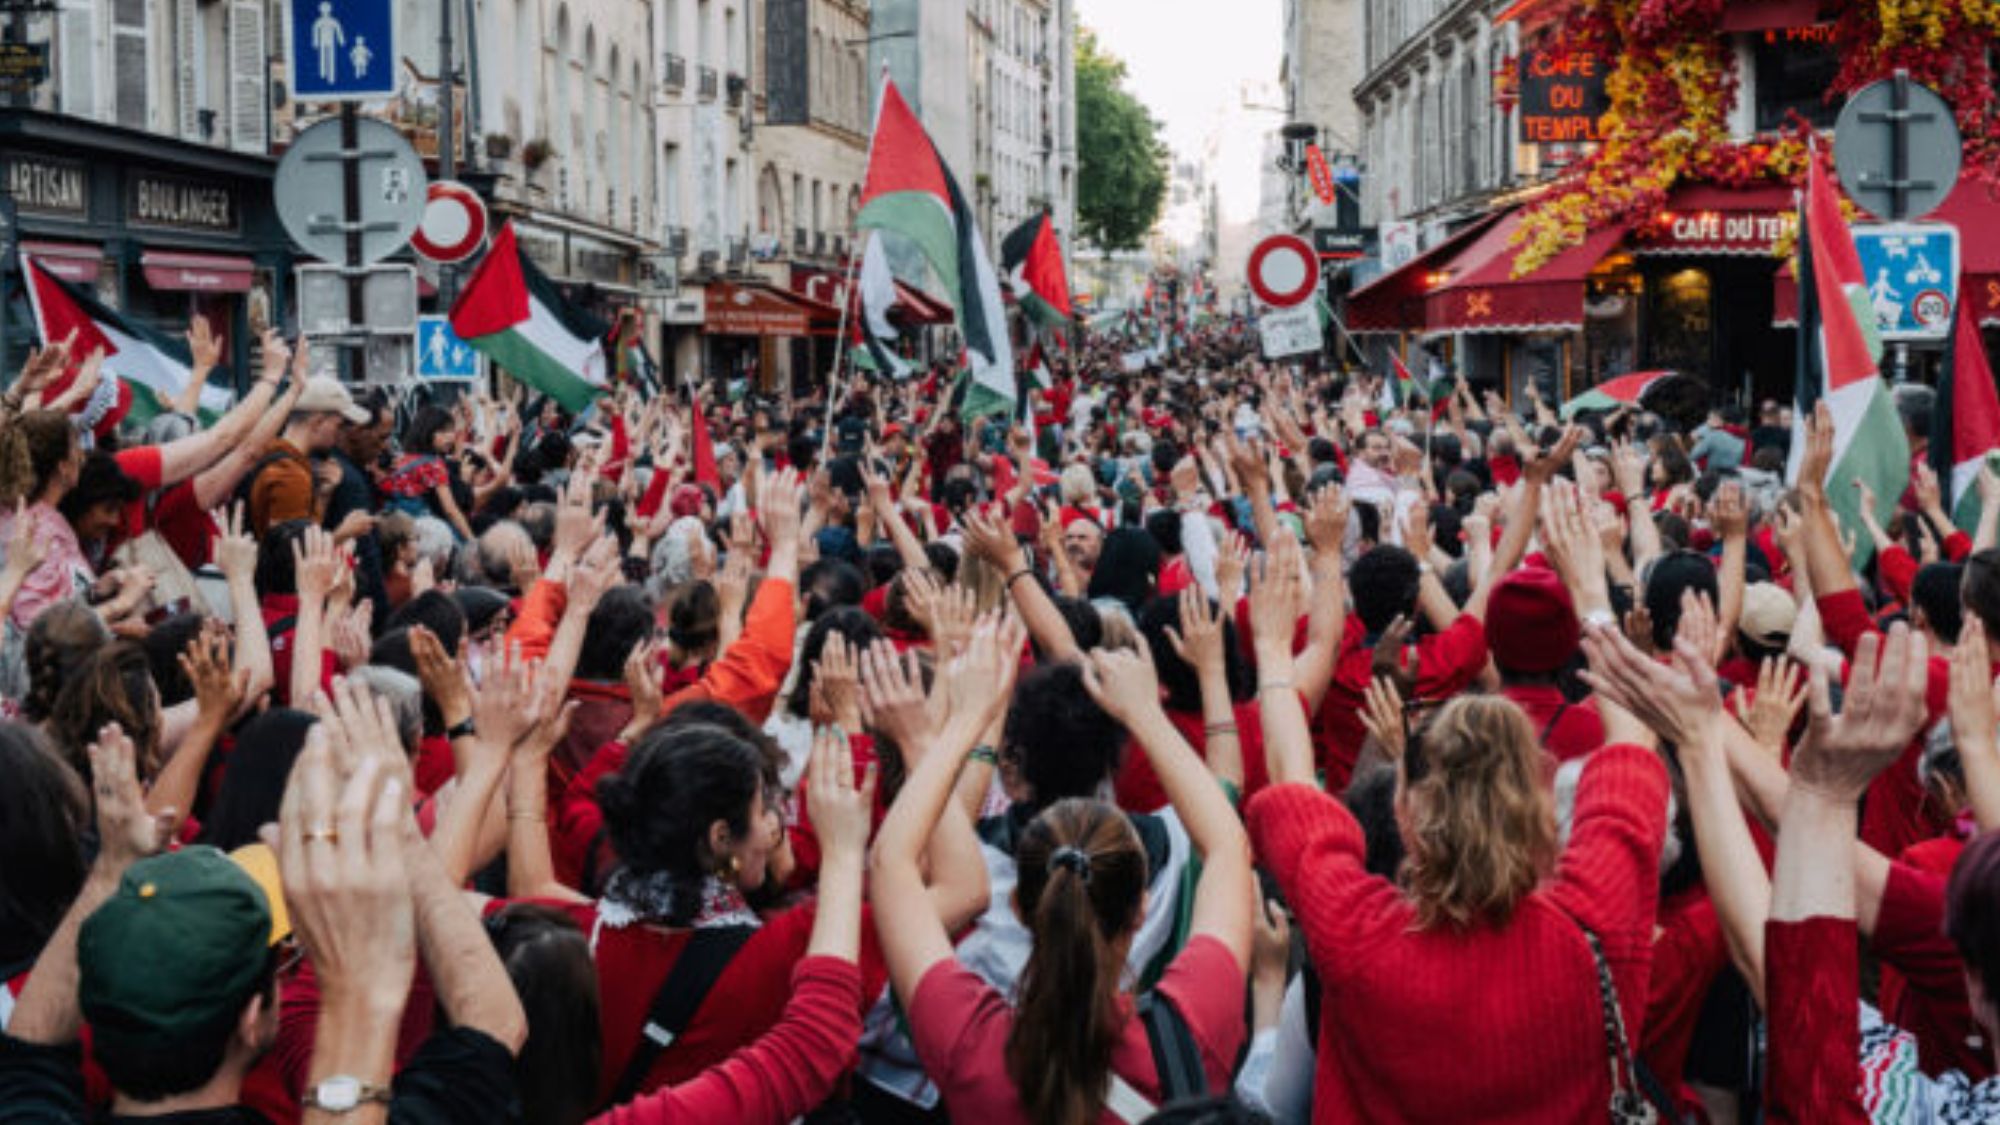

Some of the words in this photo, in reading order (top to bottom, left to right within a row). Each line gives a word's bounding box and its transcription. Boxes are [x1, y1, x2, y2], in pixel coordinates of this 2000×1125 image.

[1550, 84, 1584, 109] DU
[10, 161, 84, 207] ARTISAN
[137, 179, 230, 225] BOULANGER
[1725, 214, 1753, 240] DU
[1920, 302, 1942, 316] 20
